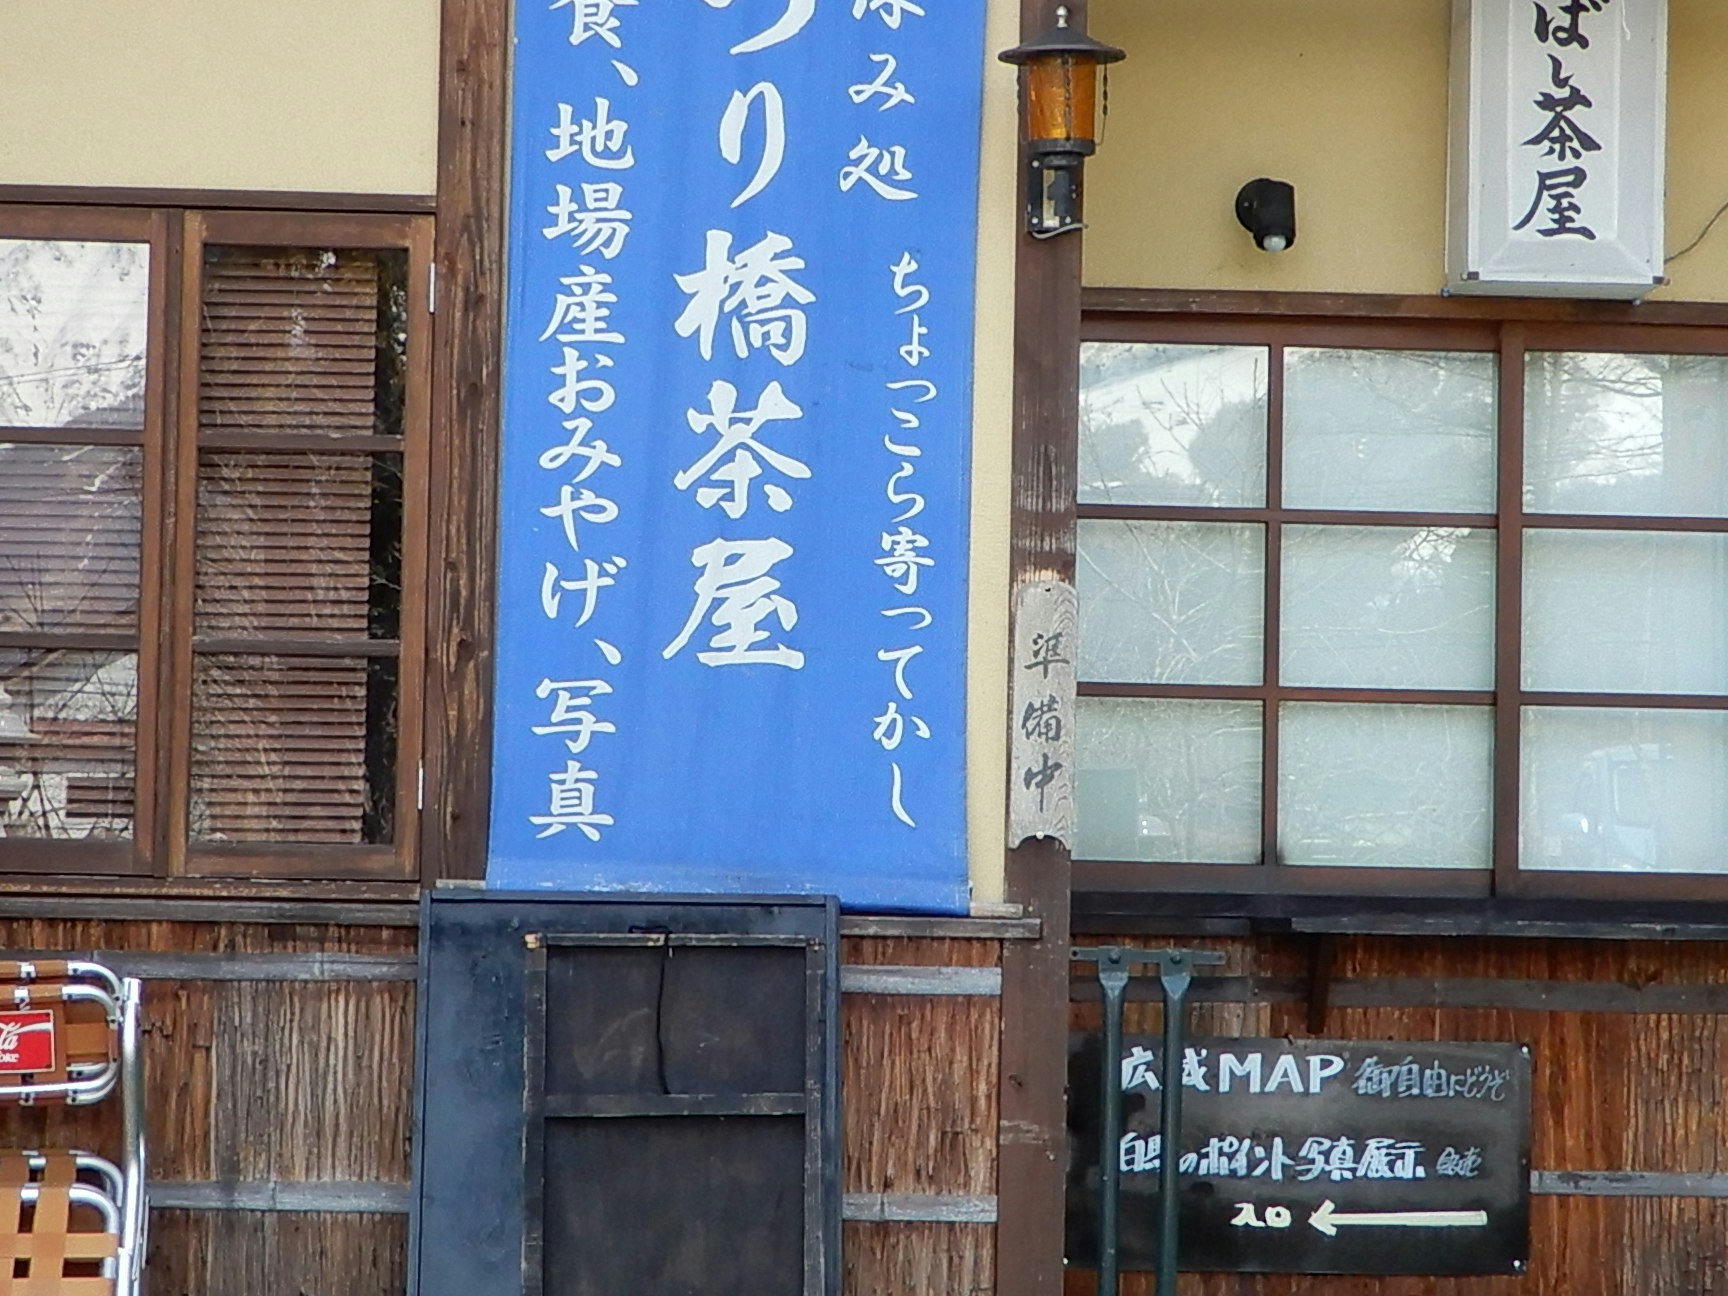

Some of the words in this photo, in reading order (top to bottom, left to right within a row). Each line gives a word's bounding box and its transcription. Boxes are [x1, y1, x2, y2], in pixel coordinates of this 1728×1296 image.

[871, 250, 940, 830] ちょっこら寄ってかし
[1021, 632, 1070, 814] 準備中
